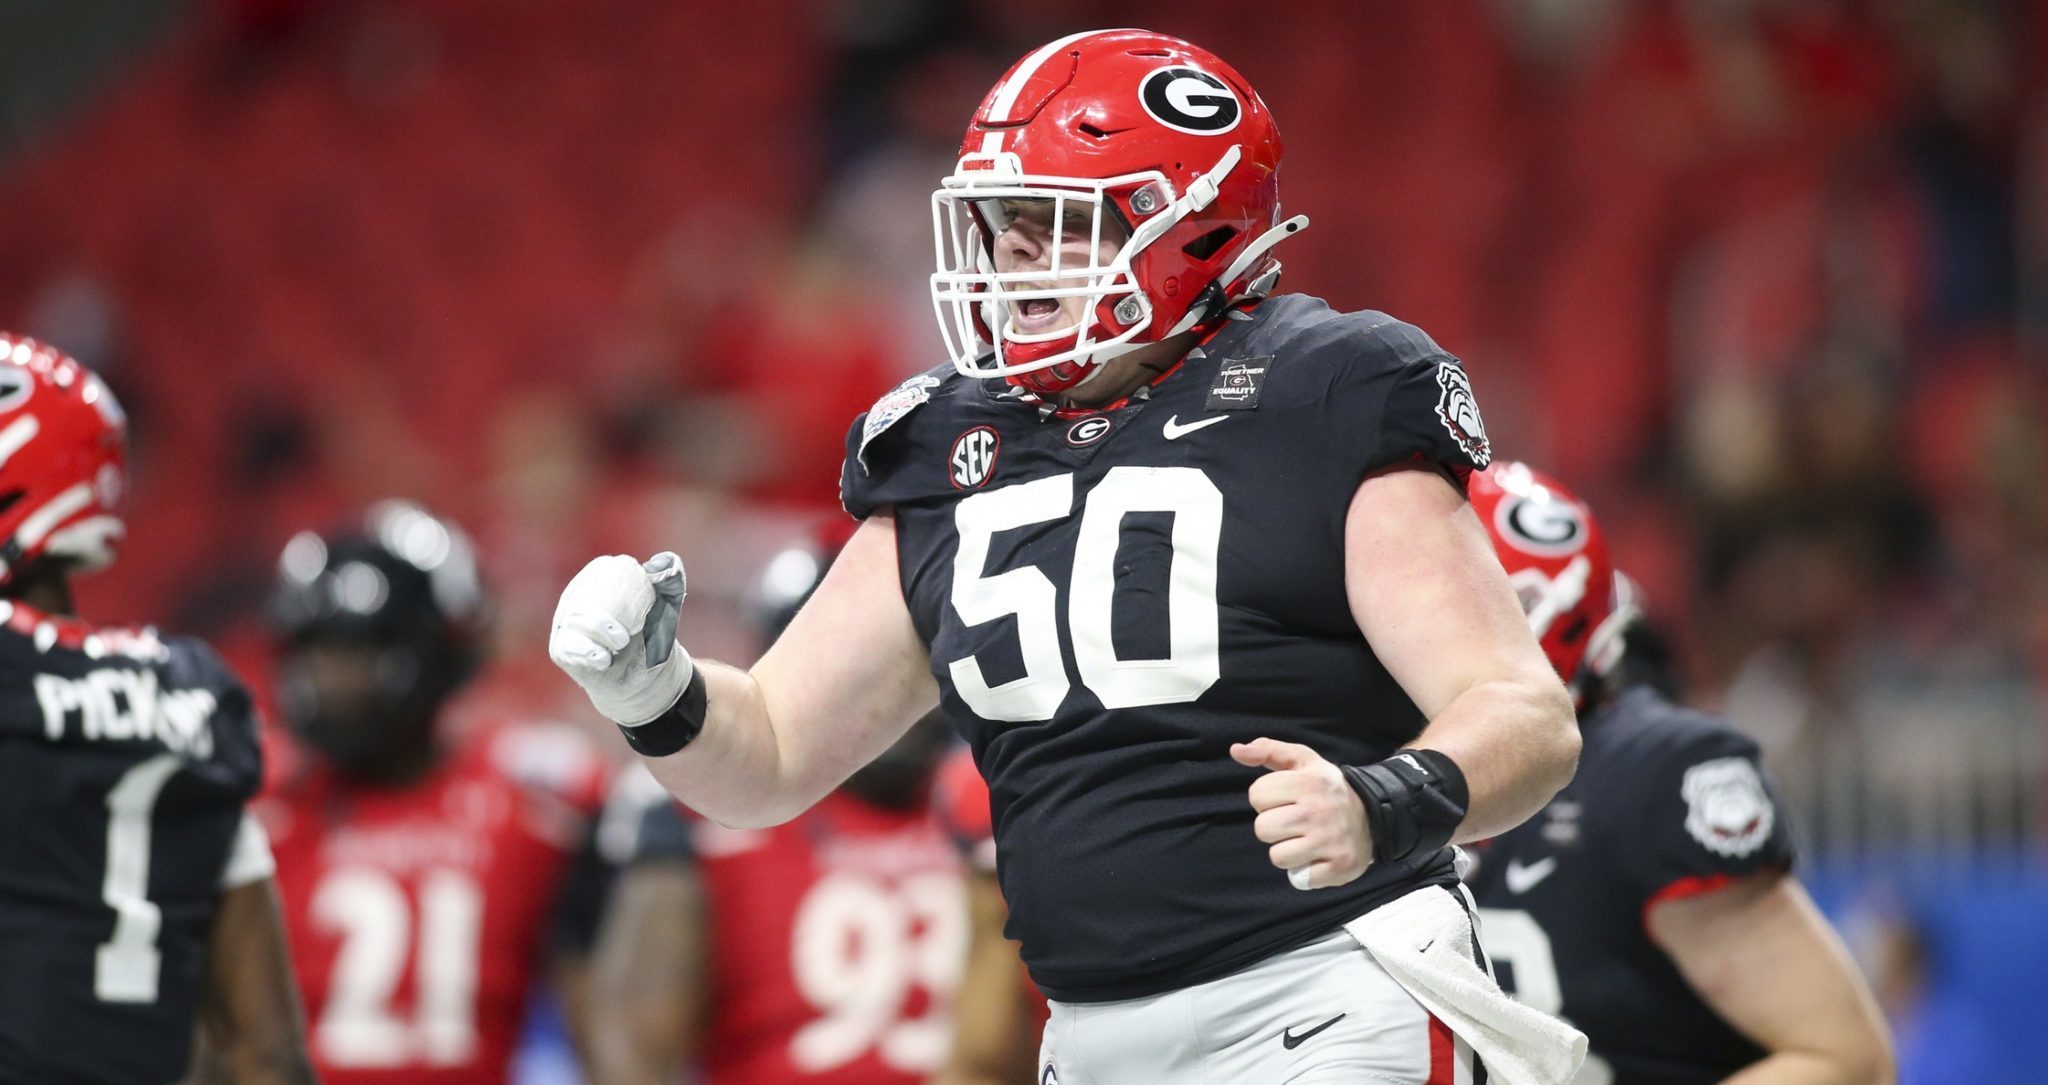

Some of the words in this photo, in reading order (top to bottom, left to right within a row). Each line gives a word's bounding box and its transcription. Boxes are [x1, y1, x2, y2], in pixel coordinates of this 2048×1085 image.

[1212, 387, 1256, 395] EQUALITY
[1221, 367, 1264, 376] TOGETHER
[952, 430, 995, 487] SEC
[949, 466, 1223, 722] 50
[95, 752, 184, 1002] 1
[309, 866, 484, 1068] 21
